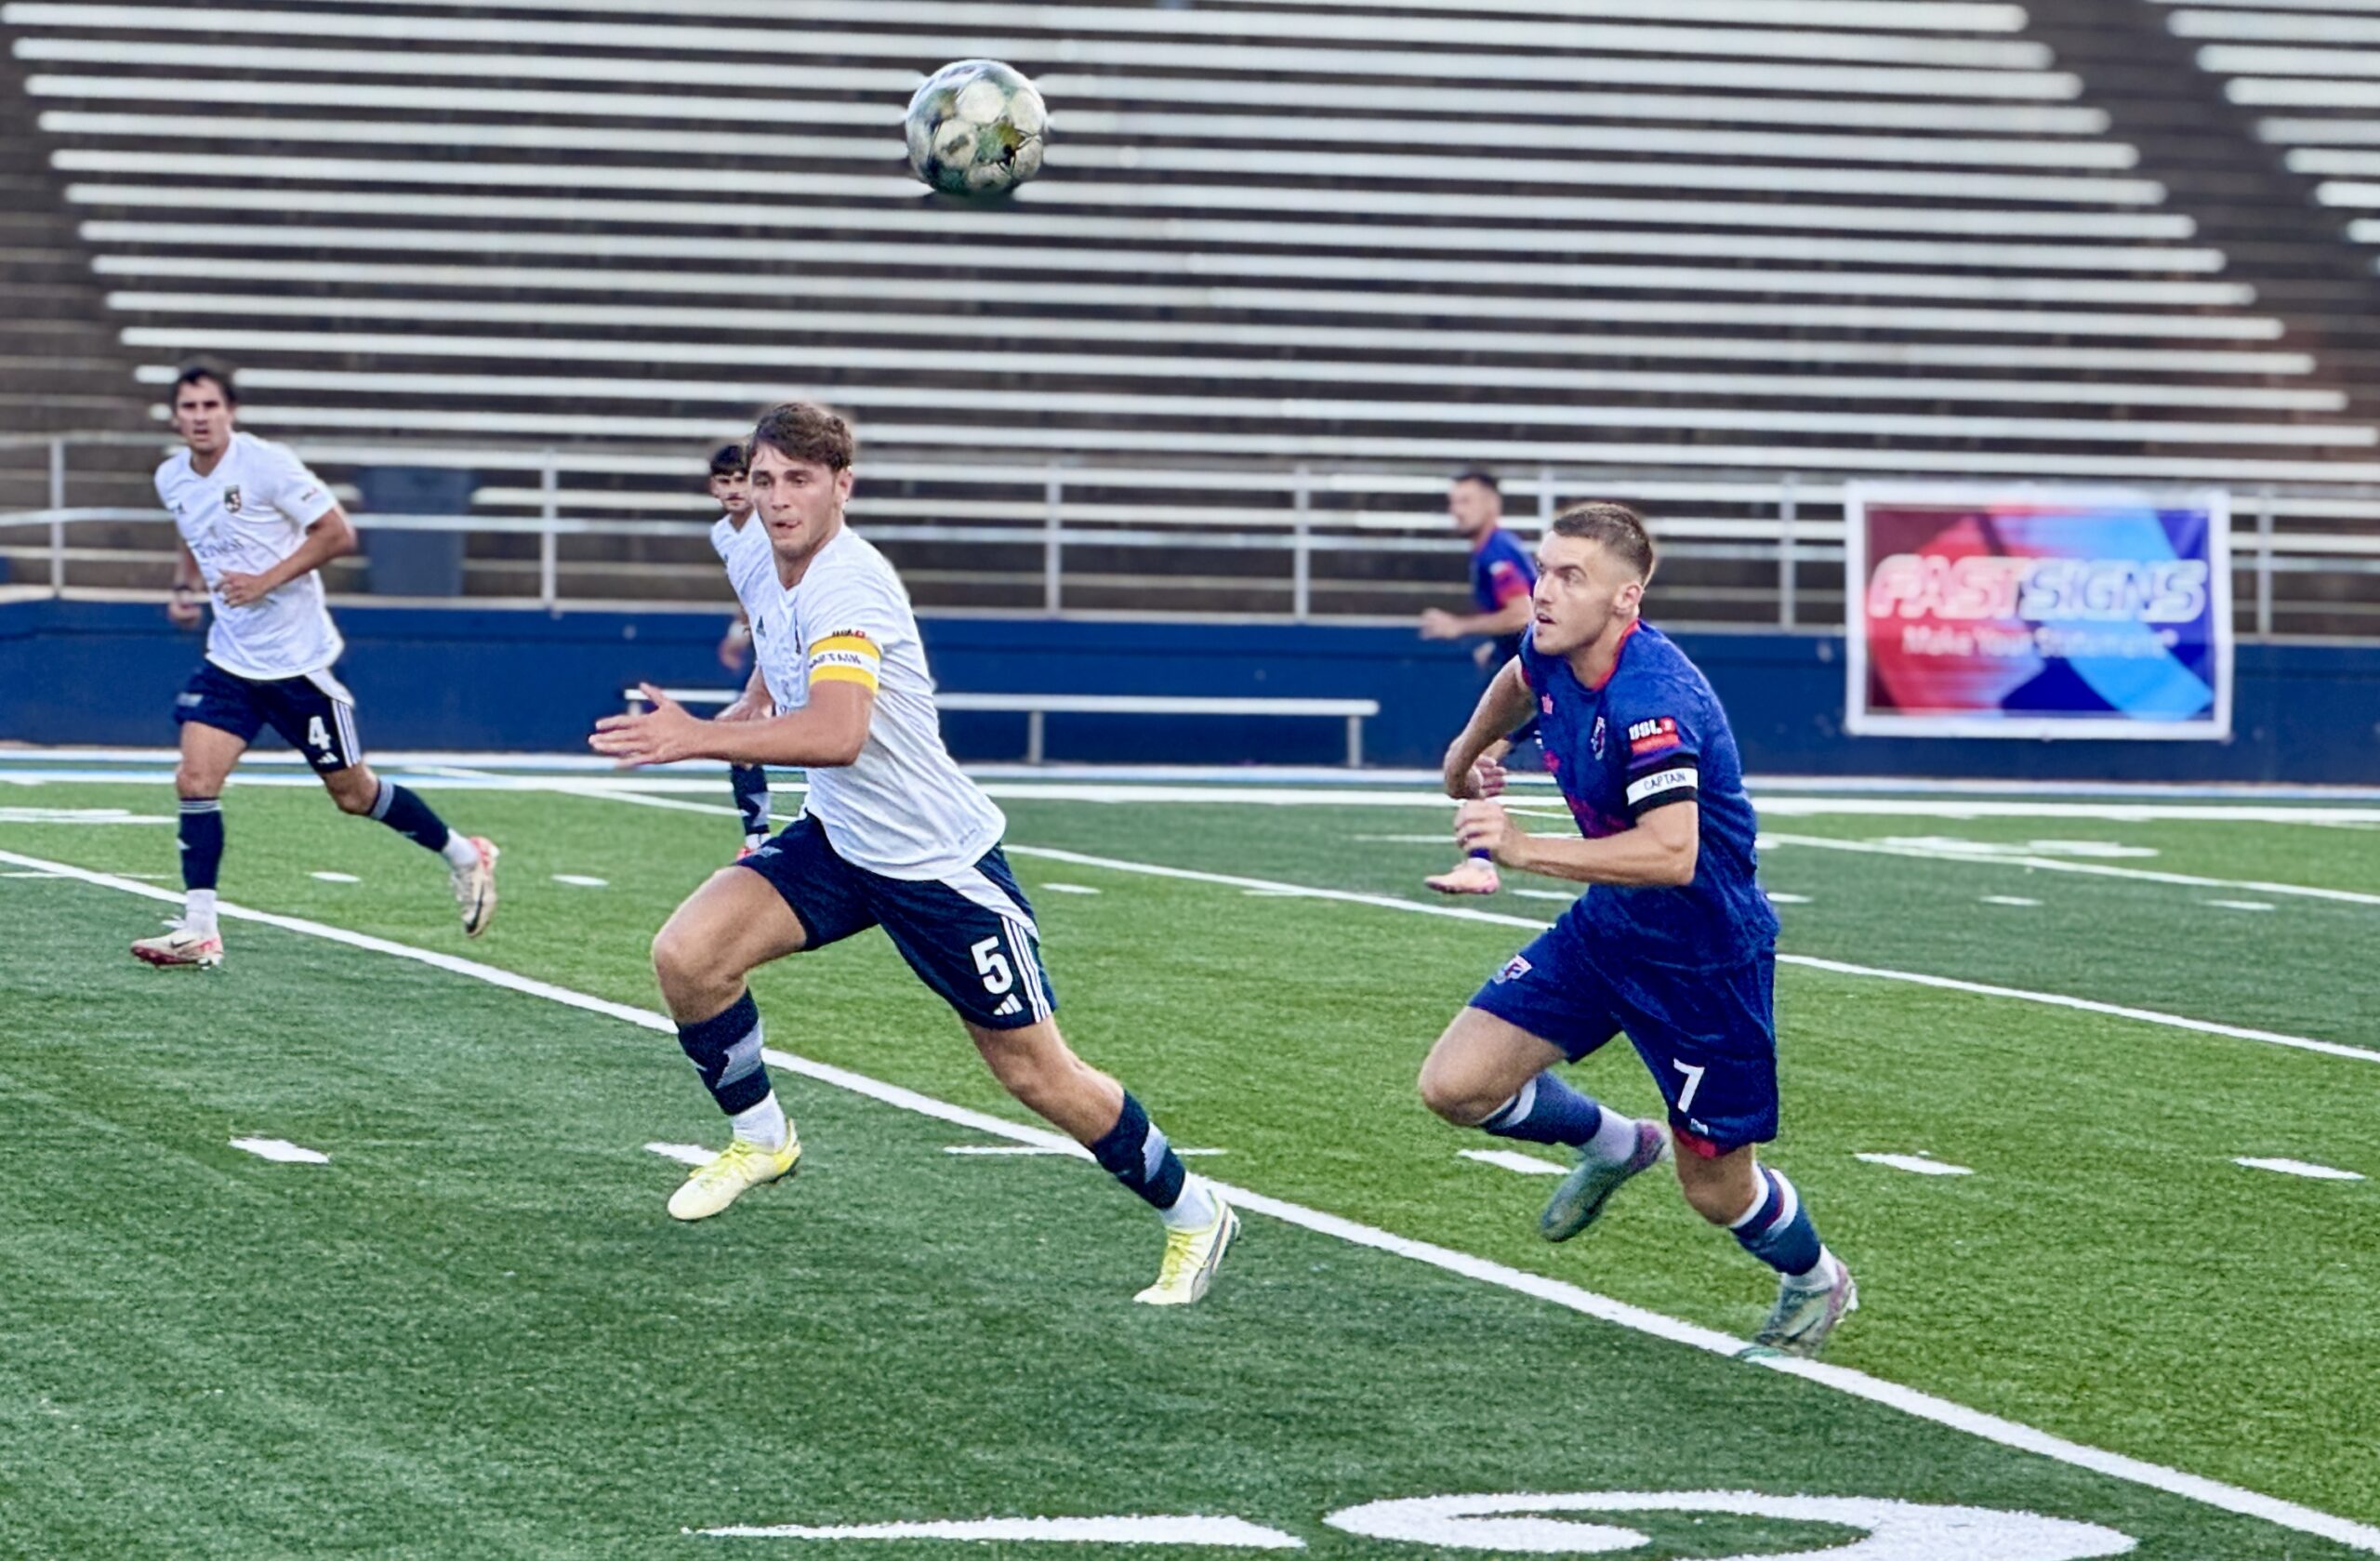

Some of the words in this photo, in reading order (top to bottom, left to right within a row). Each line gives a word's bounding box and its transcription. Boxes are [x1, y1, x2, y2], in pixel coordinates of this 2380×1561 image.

[1868, 554, 2208, 622] FASTSIGNS
[308, 716, 331, 750] 4
[1644, 774, 1686, 790] CAPTAIN
[971, 935, 1013, 994] 5
[1673, 1057, 1705, 1113] 7
